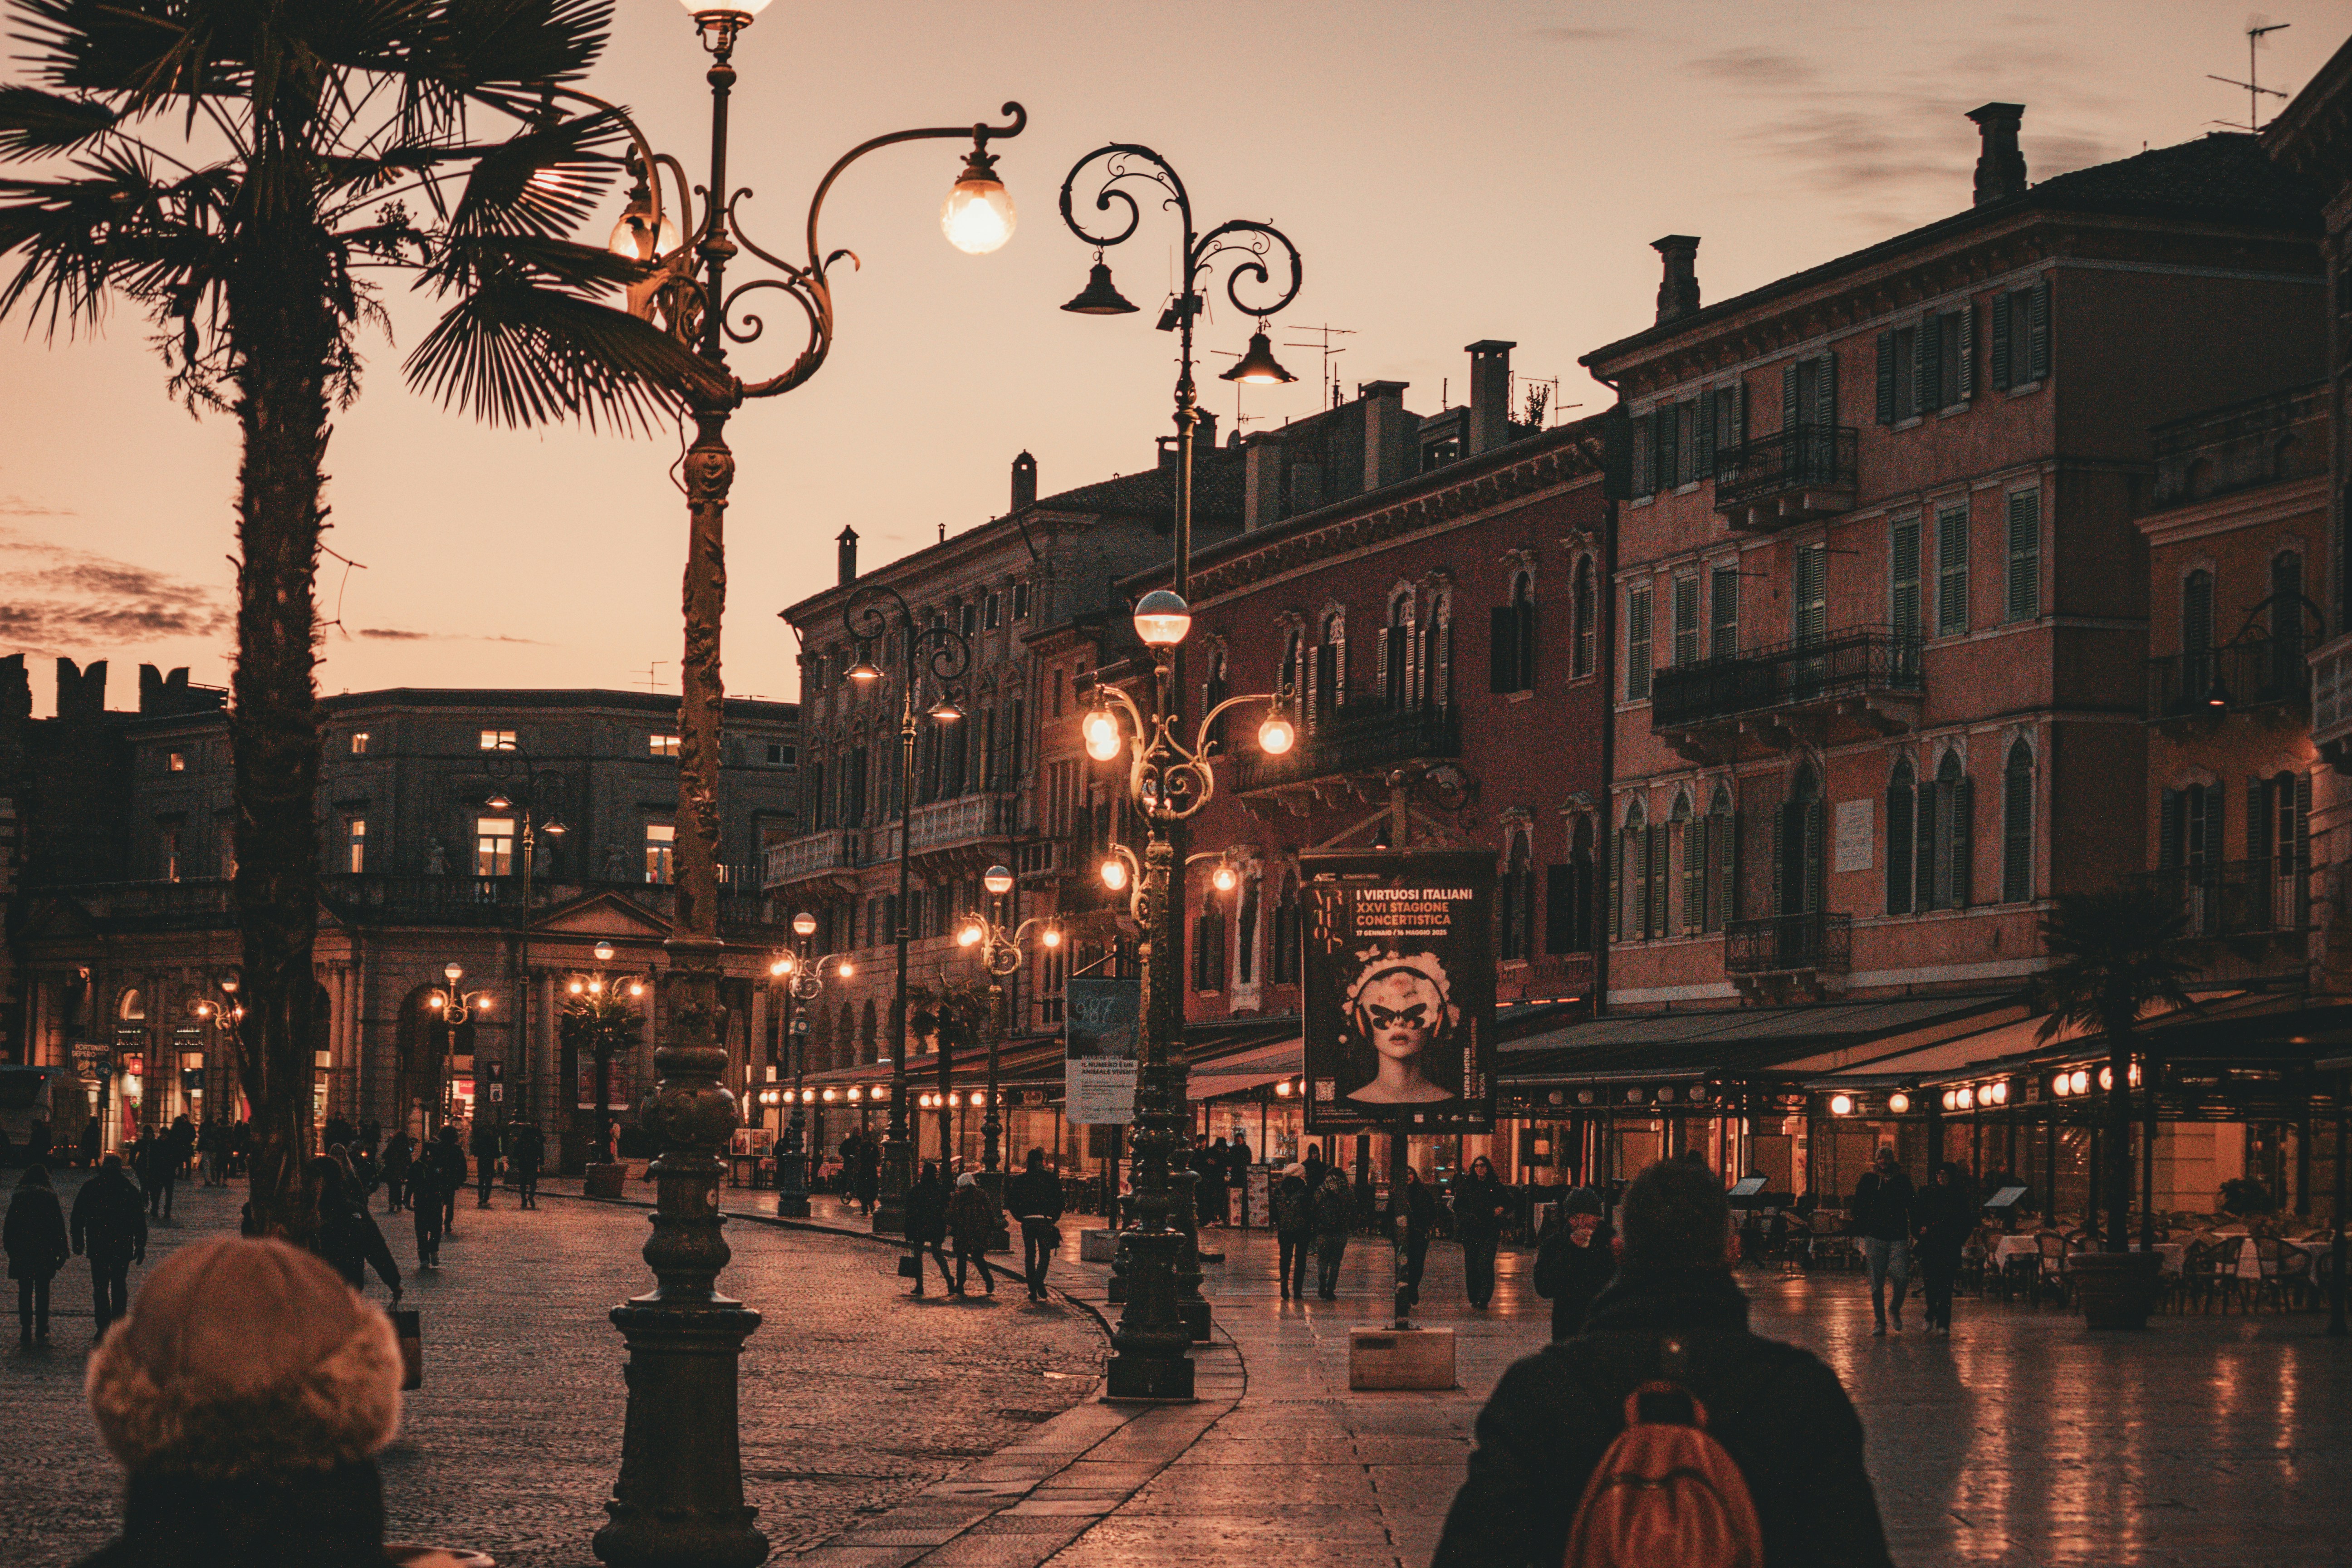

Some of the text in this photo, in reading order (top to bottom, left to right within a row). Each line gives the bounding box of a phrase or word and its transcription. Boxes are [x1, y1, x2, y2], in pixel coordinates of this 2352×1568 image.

[1356, 888, 1473, 901] I VIRTUOSI ITALIANI
[1357, 902, 1449, 913] XXVI STAGIONE
[1356, 915, 1451, 926] CONCERTISTICA
[75, 1044, 109, 1052] FORTUNATO
